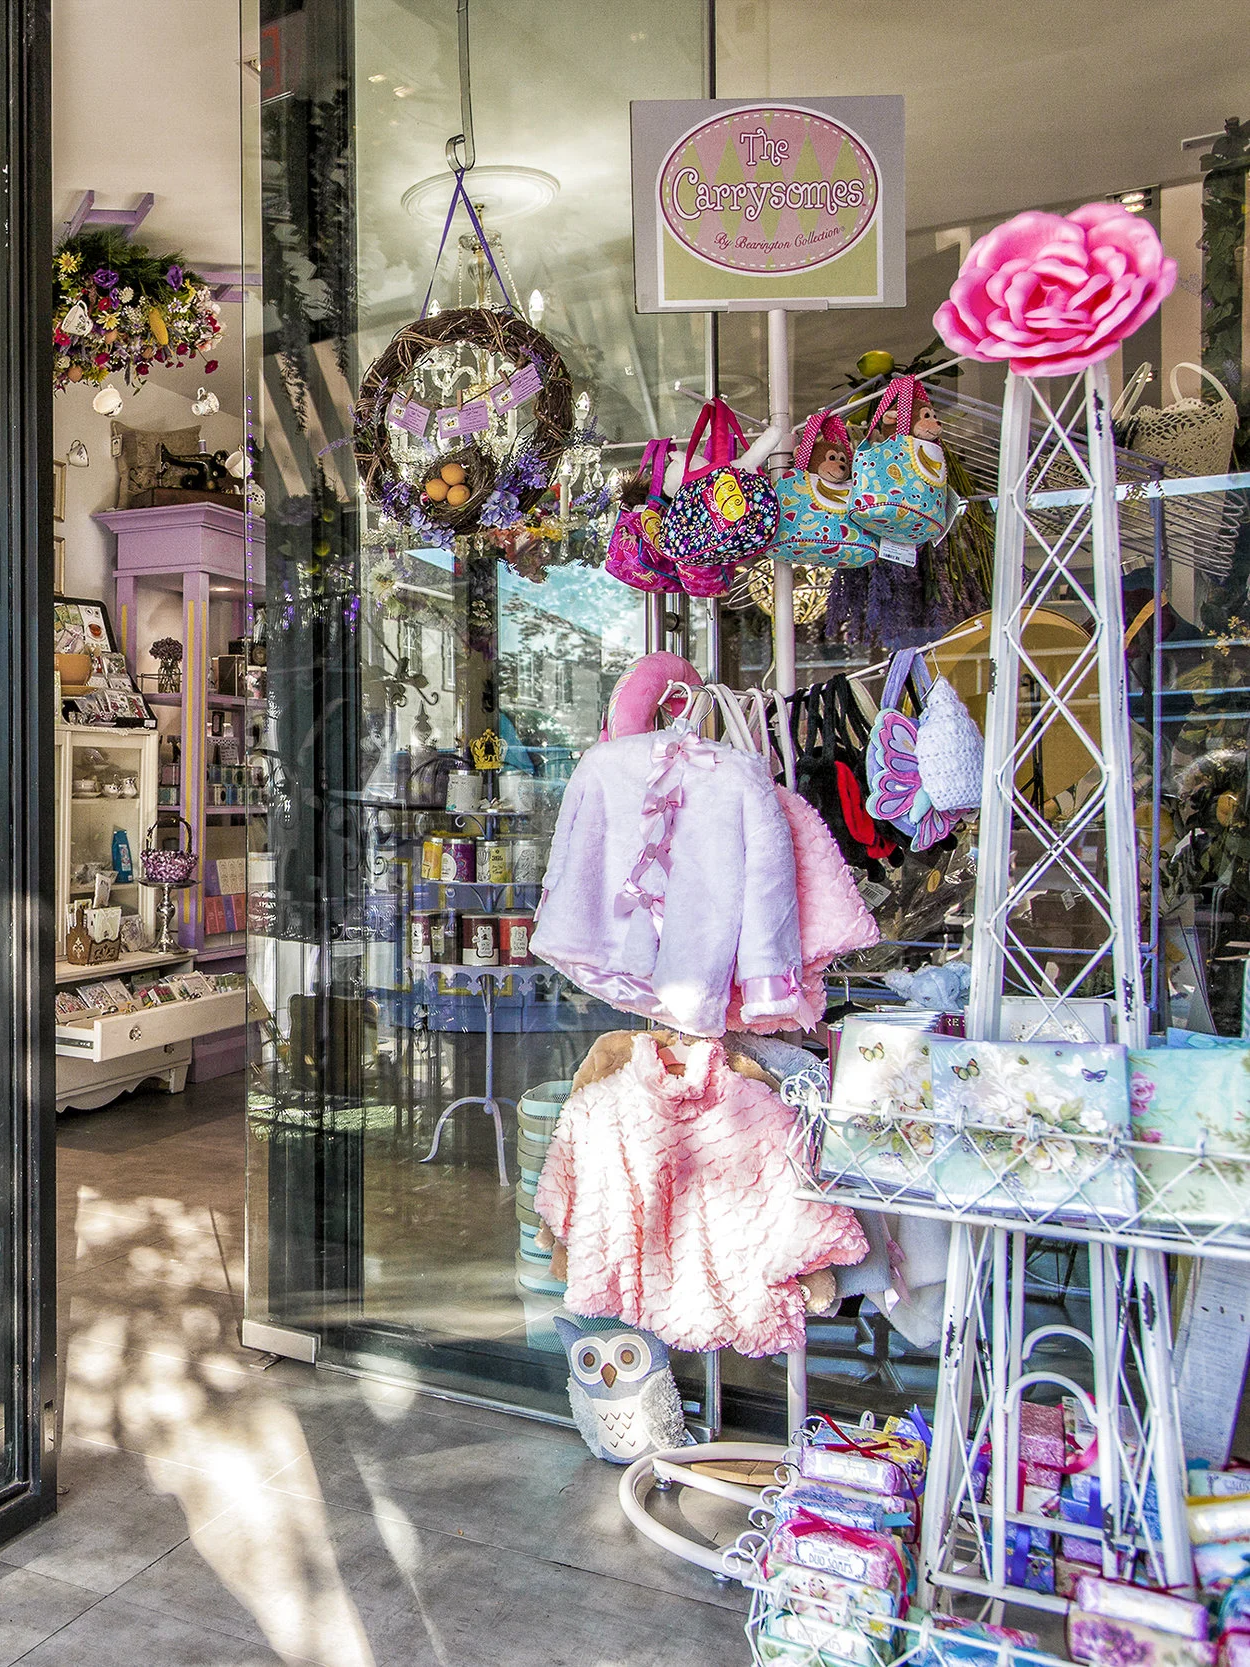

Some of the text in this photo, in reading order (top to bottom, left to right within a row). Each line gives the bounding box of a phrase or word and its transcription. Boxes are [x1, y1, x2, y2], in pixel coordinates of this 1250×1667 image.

[740, 128, 789, 166] The
[672, 167, 865, 221] Carrysomes
[714, 226, 840, 254] By Bearington Collection
